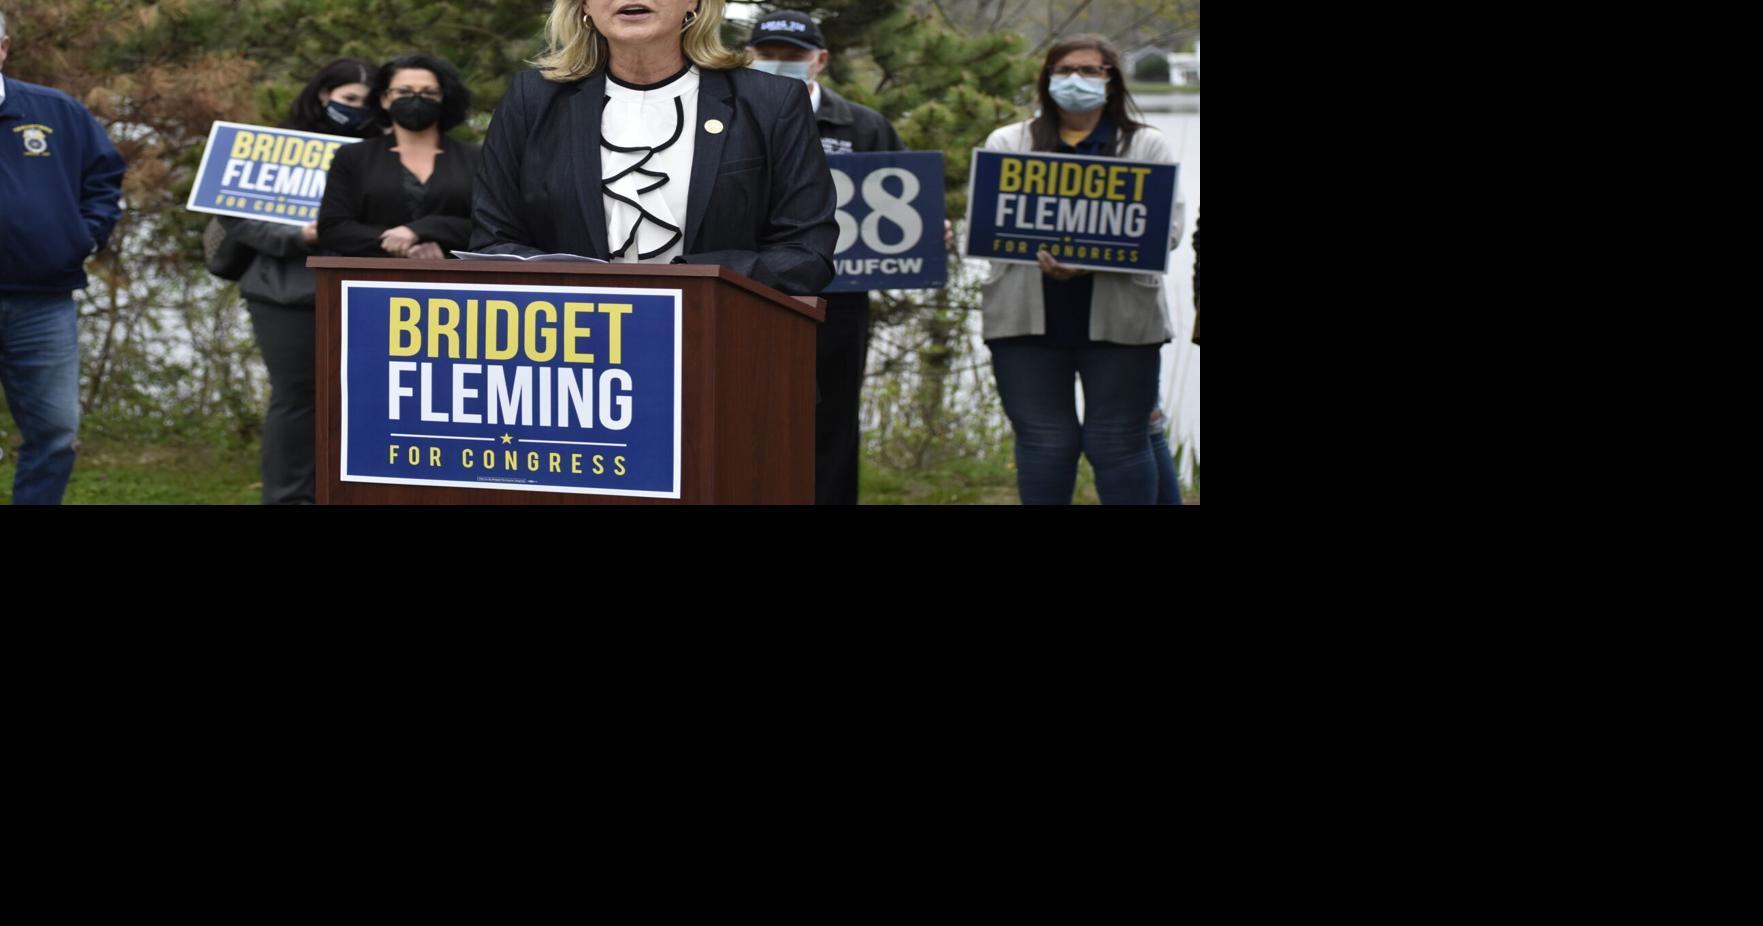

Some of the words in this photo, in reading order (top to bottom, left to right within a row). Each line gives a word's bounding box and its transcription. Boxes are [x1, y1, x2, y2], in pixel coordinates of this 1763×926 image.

[230, 130, 342, 171] BRIDGE
[215, 194, 247, 208] FOR
[999, 158, 1152, 202] BRIDGET
[995, 192, 1148, 238] FLEMING
[993, 239, 1028, 254] FOR
[388, 296, 633, 364] BRIDGET
[388, 361, 633, 431] FLEMING
[389, 444, 442, 467] FOR
[462, 448, 627, 476] CONGRESS
